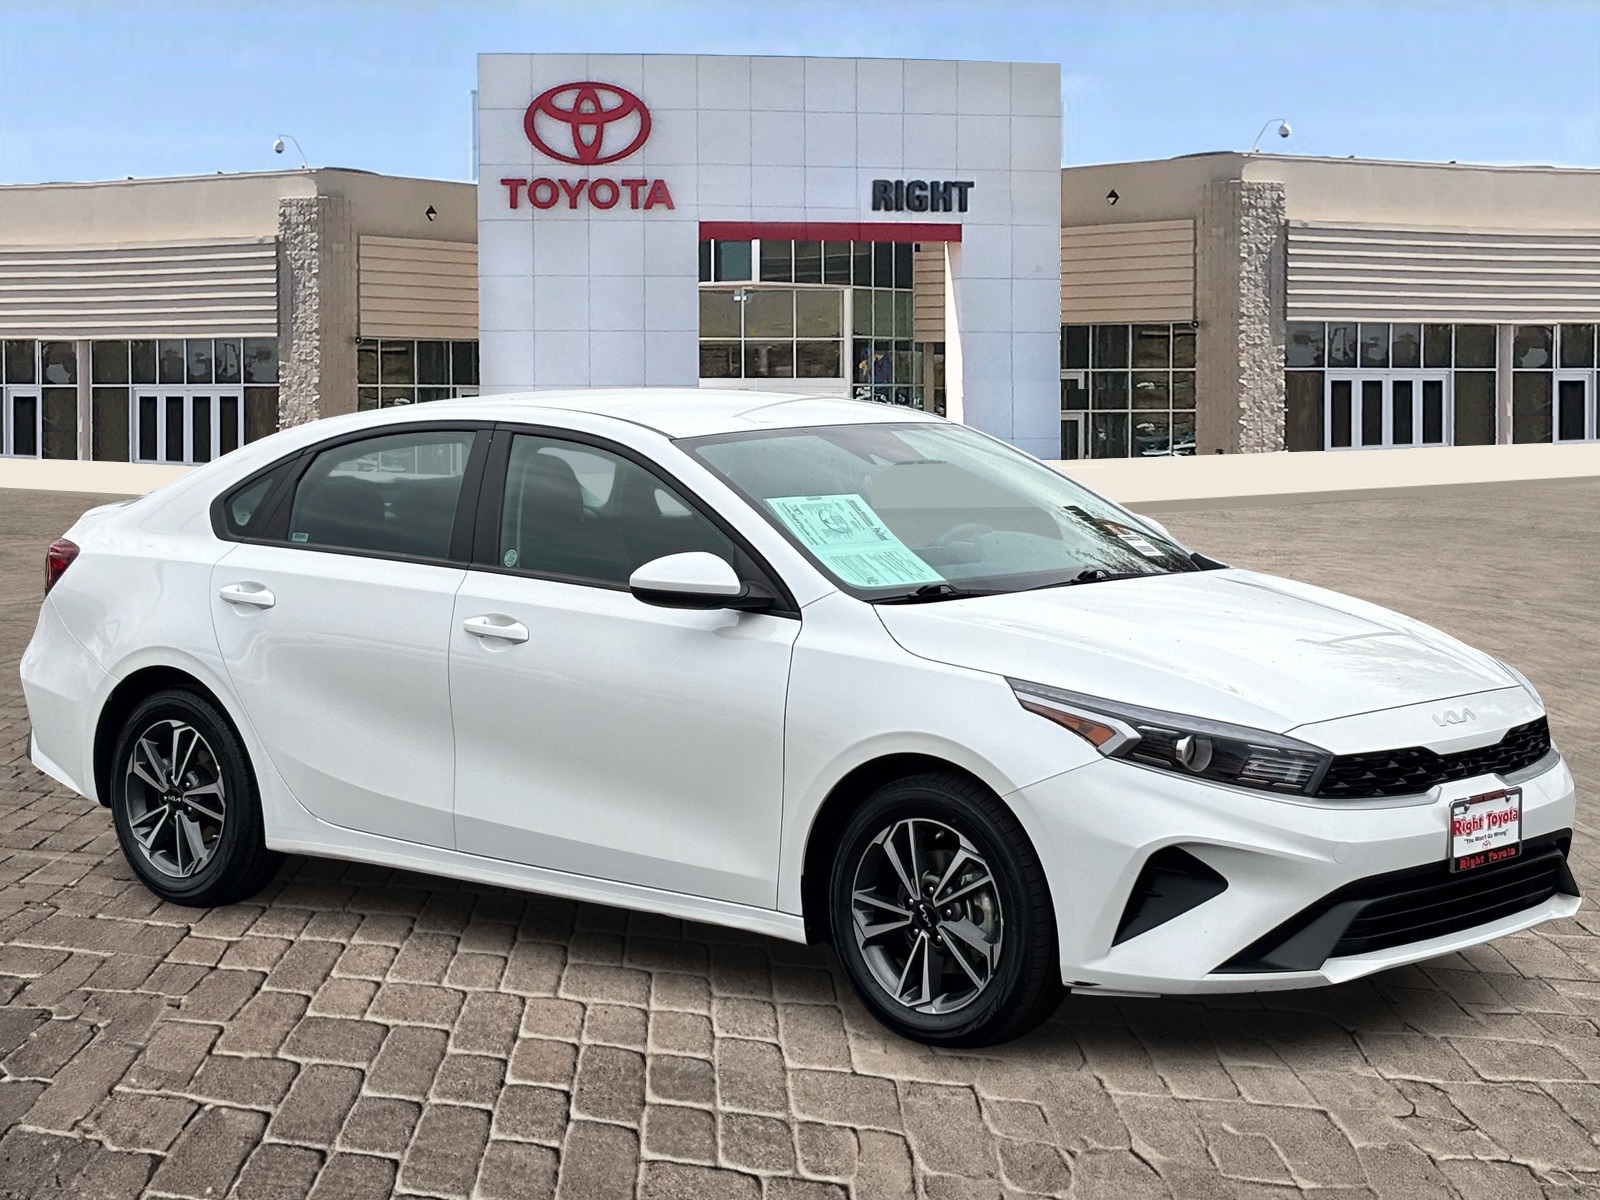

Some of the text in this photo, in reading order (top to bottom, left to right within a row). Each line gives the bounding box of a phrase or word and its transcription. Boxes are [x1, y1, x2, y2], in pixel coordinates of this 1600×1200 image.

[500, 178, 675, 210] TOYOTA
[872, 179, 975, 212] RIGHT
[1453, 807, 1519, 836] Right Toyota
[1460, 847, 1516, 870] Right Toyota
